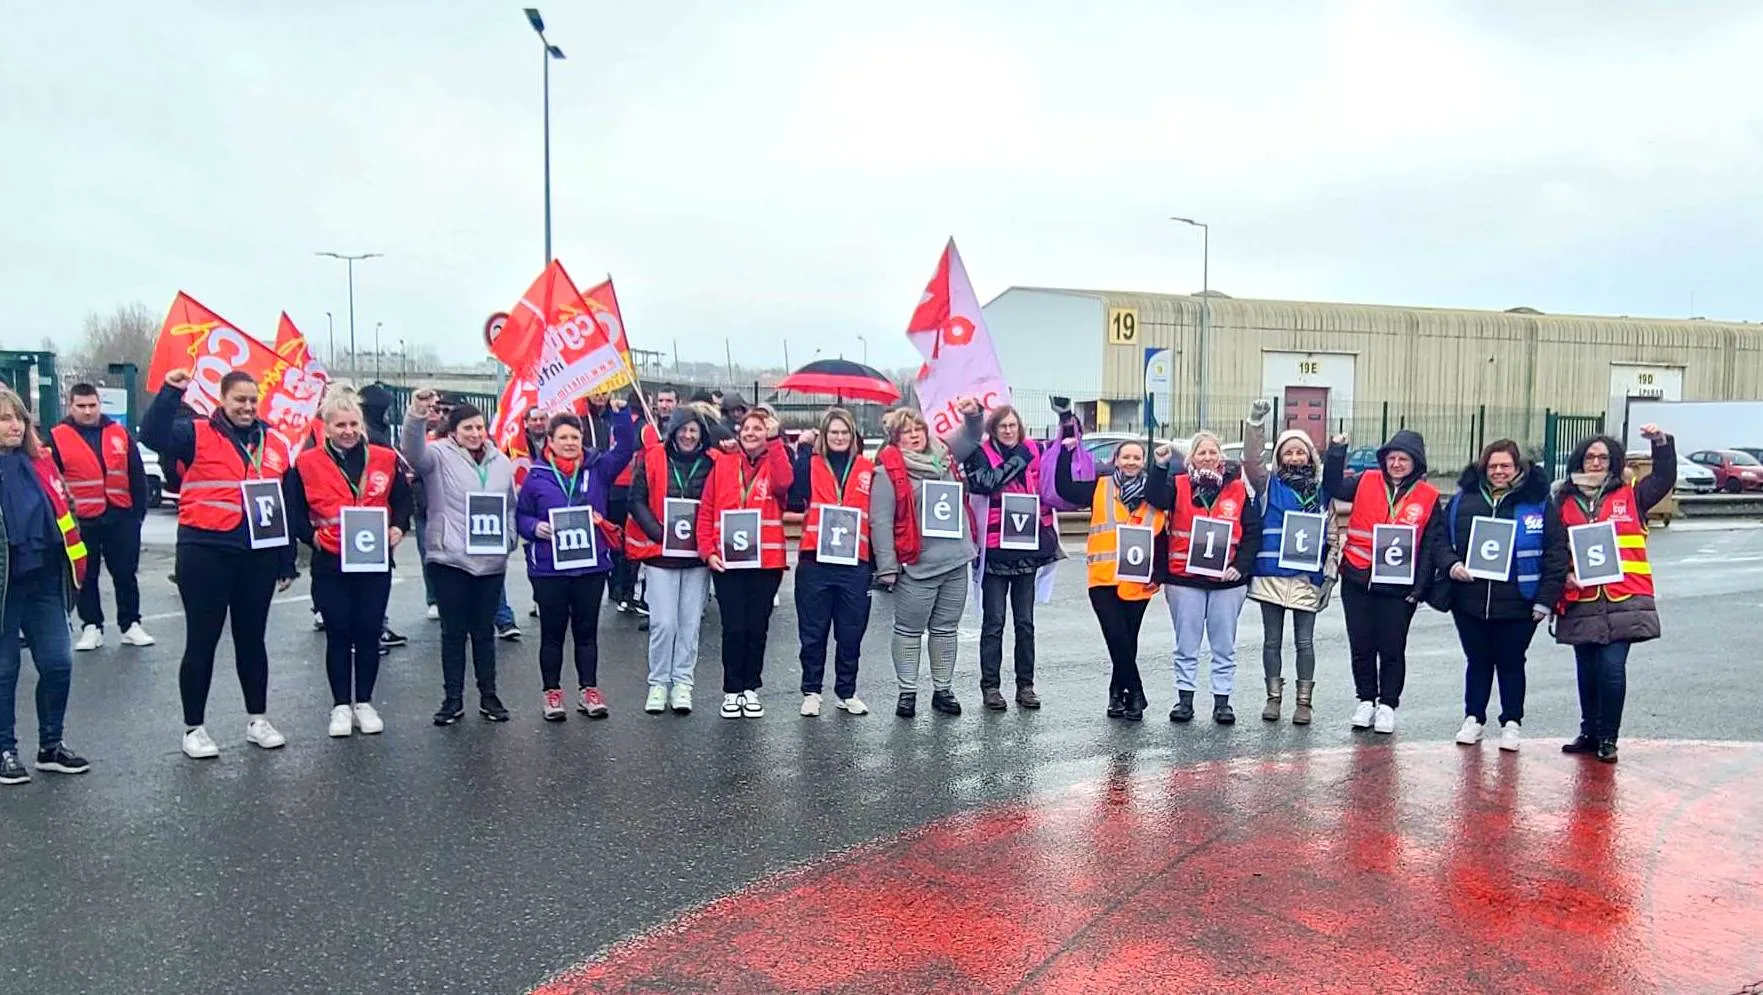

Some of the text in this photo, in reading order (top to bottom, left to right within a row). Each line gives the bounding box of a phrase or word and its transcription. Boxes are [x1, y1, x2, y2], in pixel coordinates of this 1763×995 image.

[1112, 312, 1135, 340] 19
[255, 495, 275, 527] F
[933, 492, 951, 521] é
[471, 514, 502, 535] m
[674, 519, 692, 540] e
[1011, 513, 1029, 532] v
[355, 530, 375, 553] e
[557, 528, 590, 551] m
[733, 530, 749, 551] s
[830, 526, 848, 546] r
[1294, 528, 1309, 553] t
[1127, 545, 1144, 565] o
[1384, 537, 1403, 566] é
[1480, 539, 1500, 561] e
[1587, 544, 1606, 567] s
